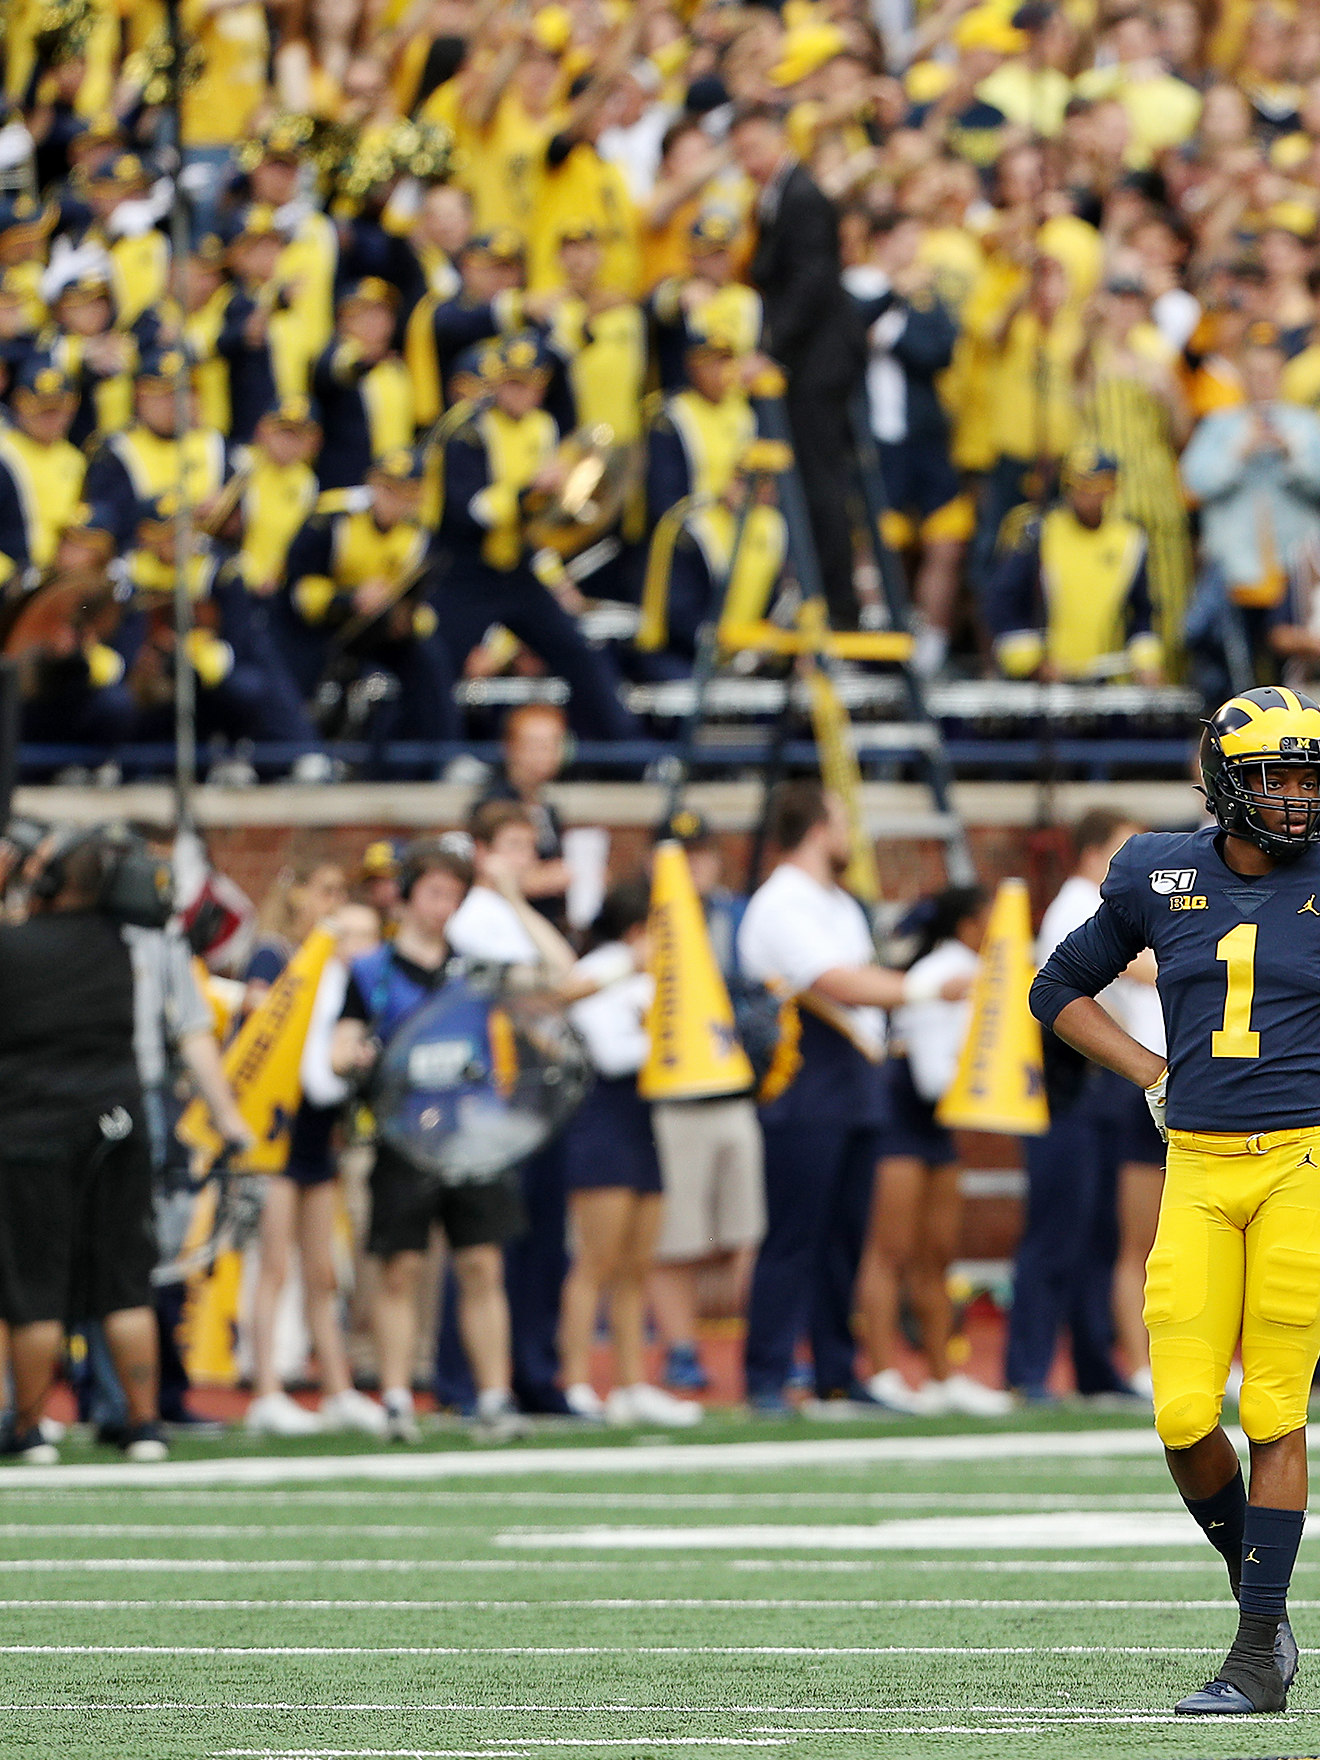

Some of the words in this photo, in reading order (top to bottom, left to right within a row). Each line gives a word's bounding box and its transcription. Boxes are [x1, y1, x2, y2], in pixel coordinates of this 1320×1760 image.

[1297, 738, 1310, 749] M
[1148, 868, 1197, 894] 150
[1211, 923, 1260, 1058] 1
